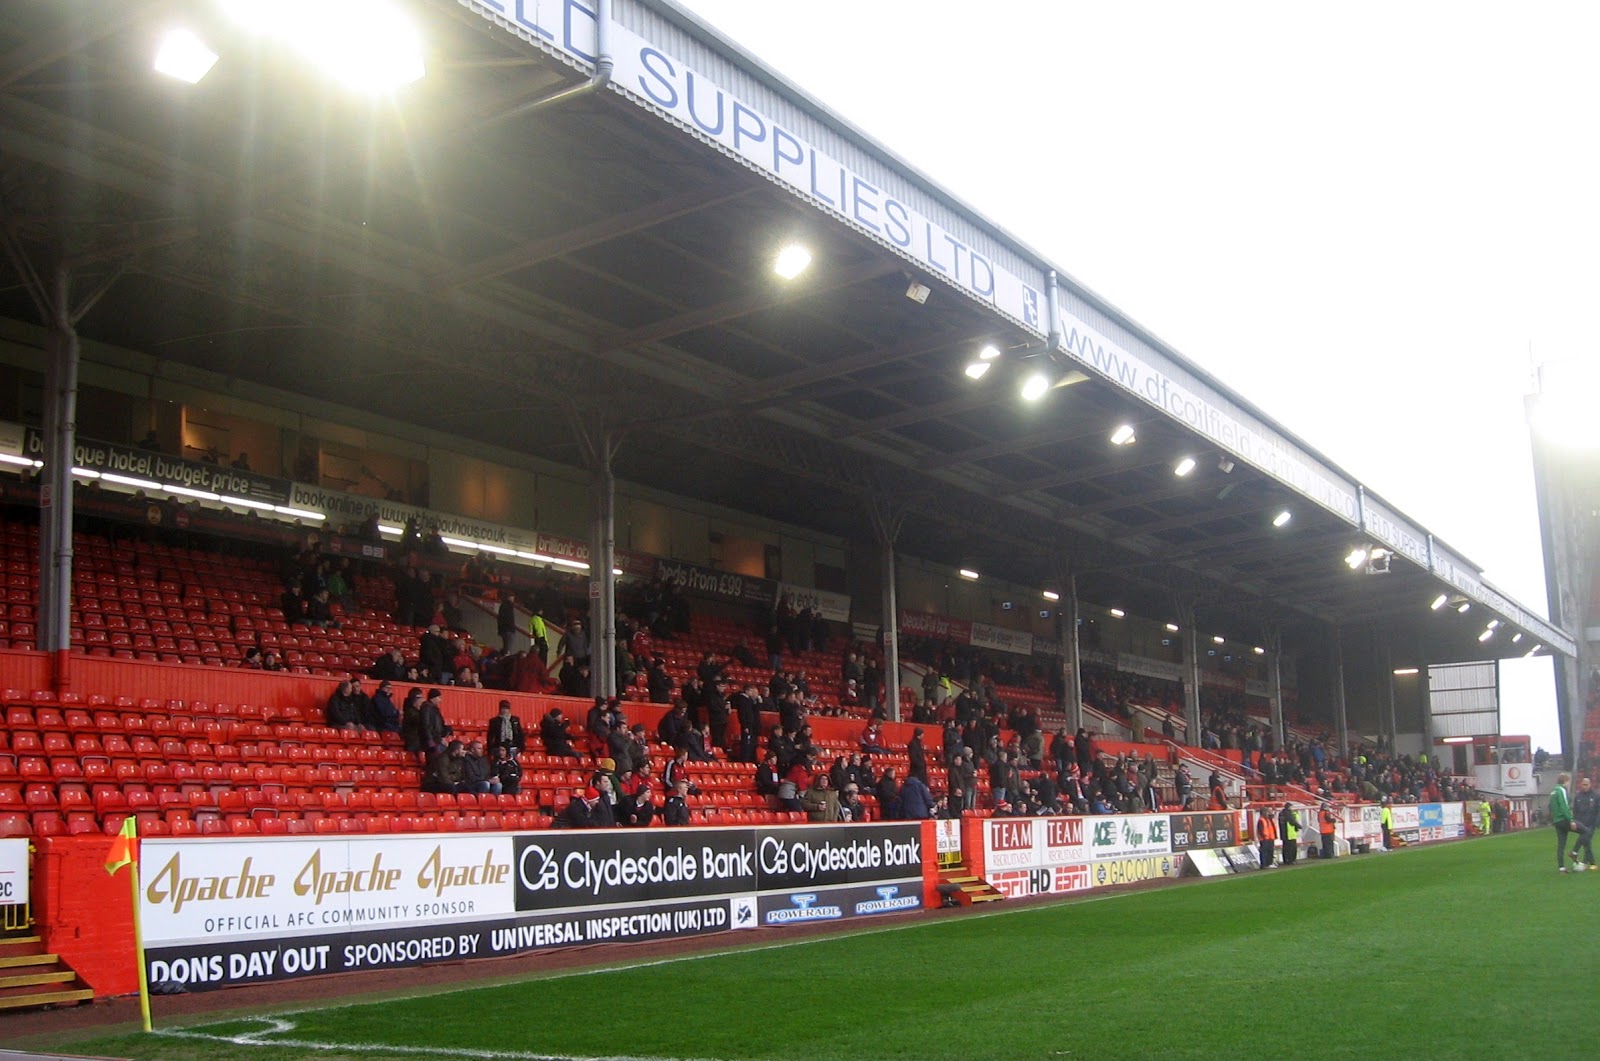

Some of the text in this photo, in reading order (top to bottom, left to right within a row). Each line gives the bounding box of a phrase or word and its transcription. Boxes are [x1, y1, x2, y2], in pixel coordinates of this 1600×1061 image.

[484, 0, 993, 297] LD SUPPLIES LTD
[107, 446, 153, 478] hotel,
[155, 457, 210, 488] budget
[211, 471, 249, 493] price
[294, 486, 325, 509] book
[327, 496, 363, 516] online
[538, 535, 575, 556] brilliant
[688, 567, 717, 592] from
[719, 573, 743, 596] £99
[992, 823, 1032, 848] TEAM
[1047, 821, 1083, 844] TEAM
[1174, 832, 1189, 845] SPEX
[1196, 830, 1209, 843] SPEX
[1216, 829, 1229, 841] SPEX
[417, 844, 510, 898] Apache
[563, 847, 697, 895] Clydesdale
[702, 845, 754, 879] Bank
[790, 840, 881, 879] Clydesdale
[884, 837, 921, 867] Bank
[1110, 858, 1157, 884] GAC.COM
[147, 851, 275, 914] Apache
[293, 848, 402, 906] Apache
[992, 869, 1051, 897] ESPN HD
[1055, 865, 1088, 891] ESPN
[204, 900, 475, 933] OFFICIAL AFC COMMUNITY SPONSOR
[767, 907, 840, 922] POWERADE
[856, 897, 917, 913] POWERADE
[151, 907, 726, 984] DONS DAY OUT SPONSORED BY UNIVERSAL INSPECTION (UK) LTD
